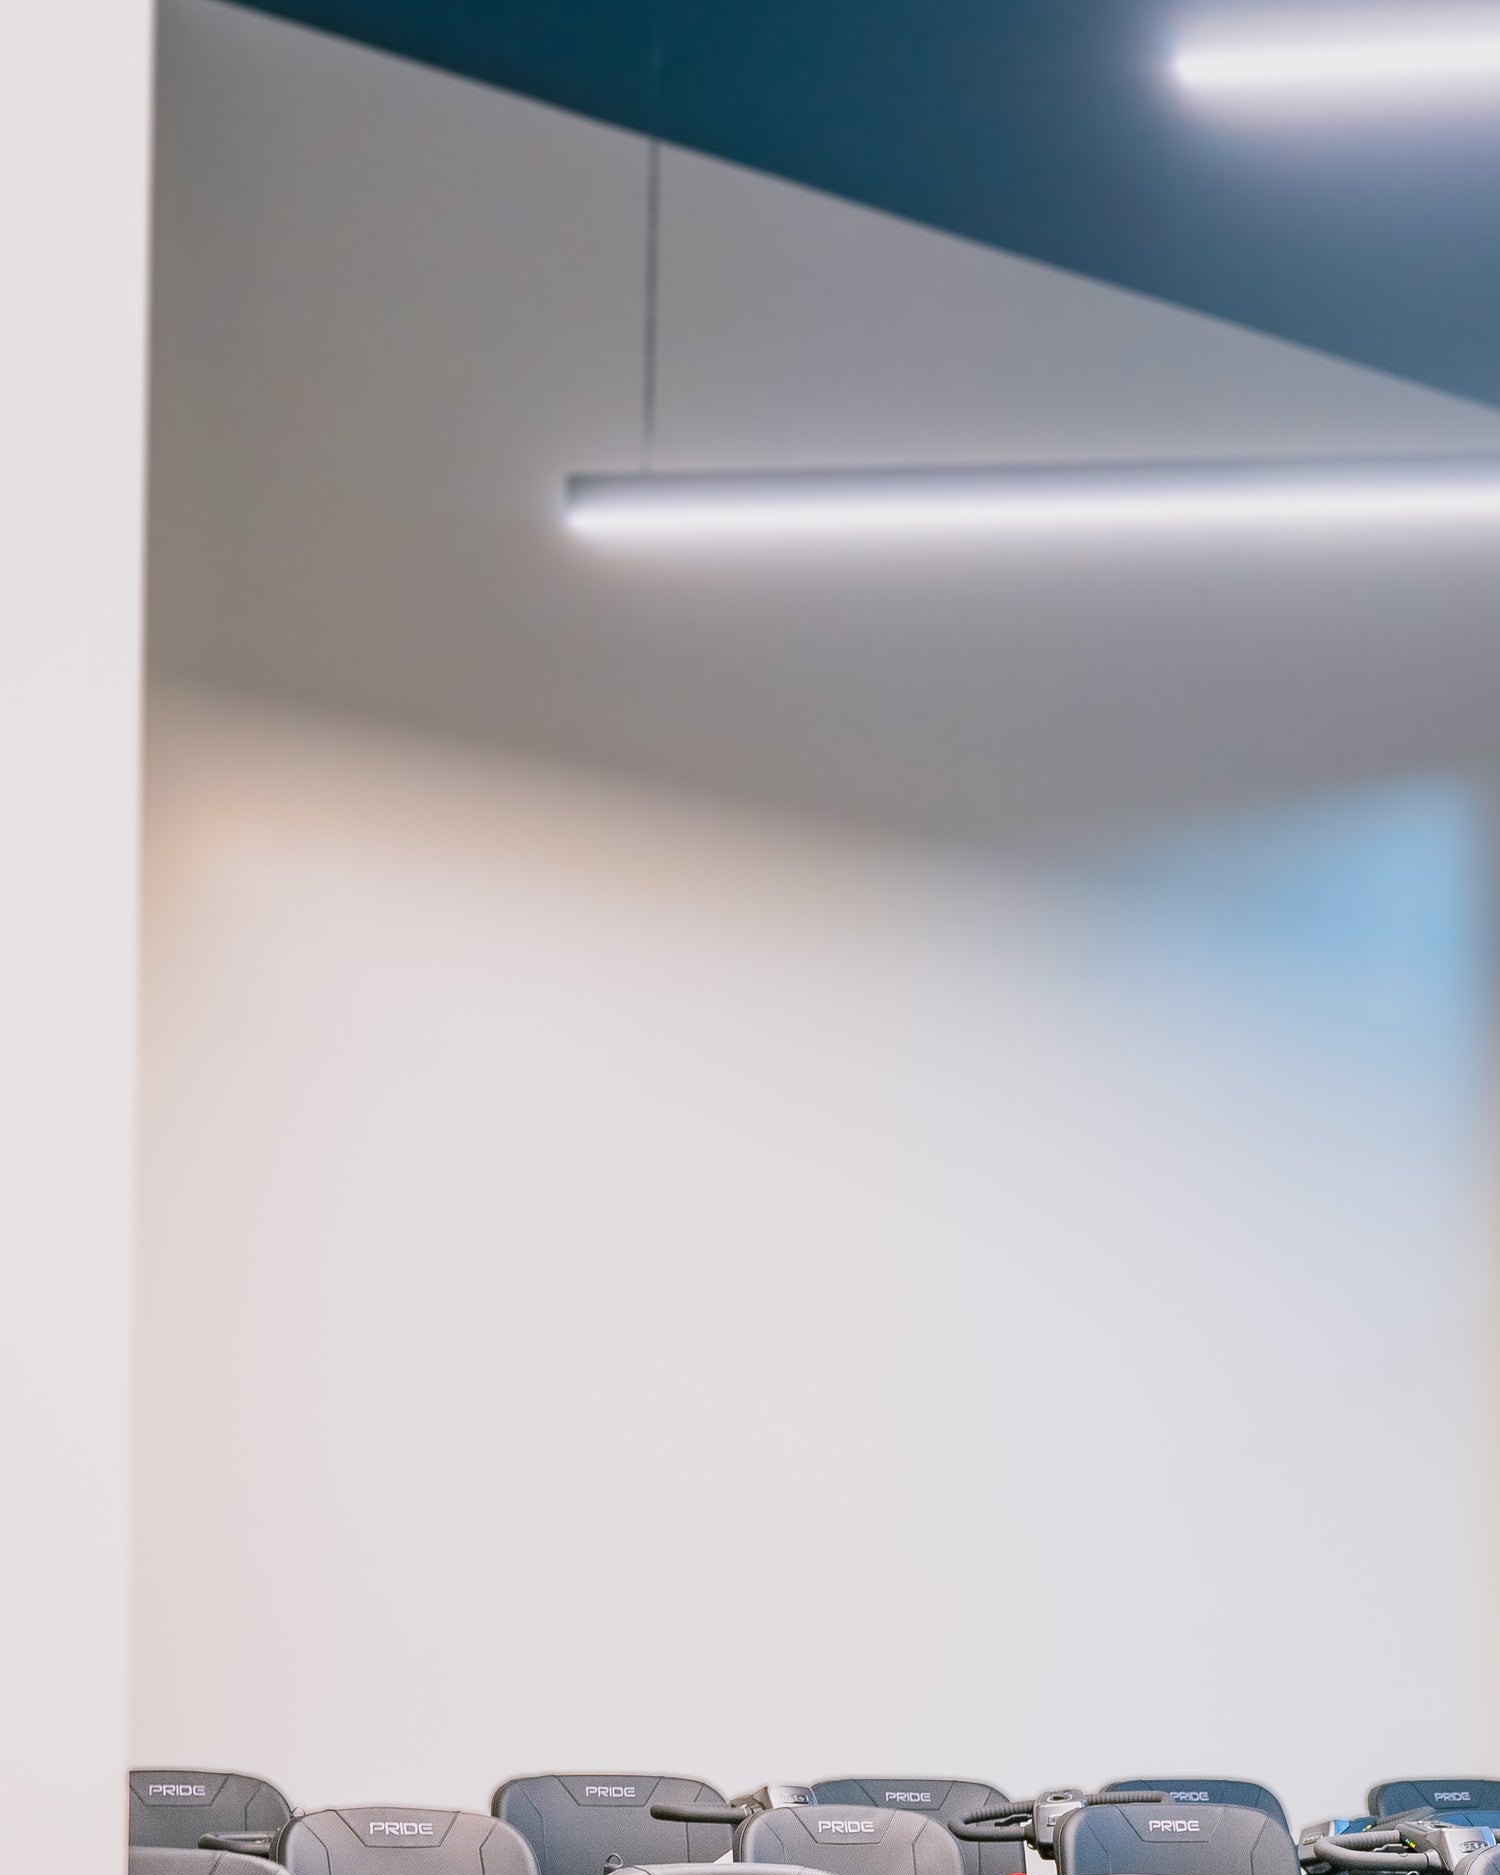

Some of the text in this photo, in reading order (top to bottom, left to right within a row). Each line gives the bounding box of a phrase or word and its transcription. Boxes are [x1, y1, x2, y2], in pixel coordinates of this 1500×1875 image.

[149, 1784, 205, 1796] PRIDE
[585, 1786, 636, 1798] PRIDE
[885, 1791, 932, 1803] PRIDE
[1434, 1792, 1470, 1802] PRIDE
[369, 1822, 433, 1835] PRIDE
[818, 1821, 875, 1834] PRIDE
[1148, 1820, 1199, 1832] PRIDE
